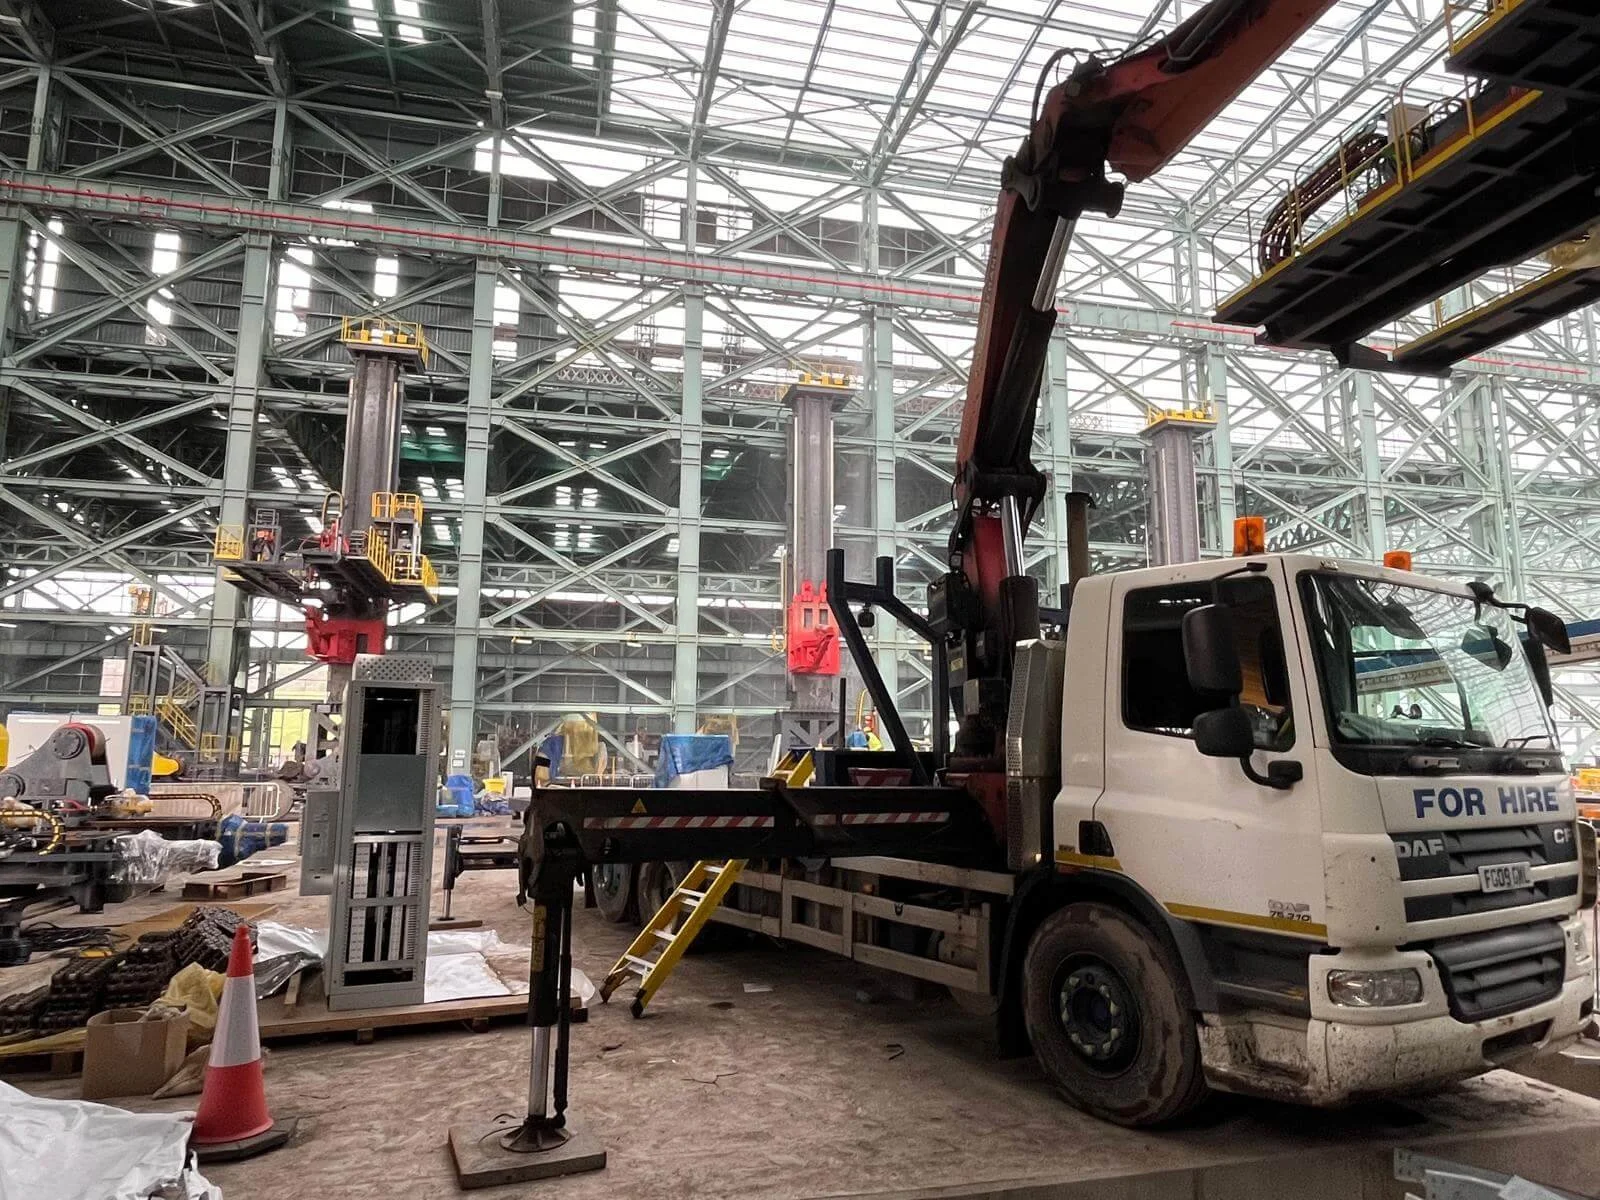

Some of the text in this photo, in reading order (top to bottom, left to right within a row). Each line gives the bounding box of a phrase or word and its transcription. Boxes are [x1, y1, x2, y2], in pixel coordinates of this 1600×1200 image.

[1413, 786, 1559, 818] FOR HIRE
[1394, 839, 1444, 858] DAF
